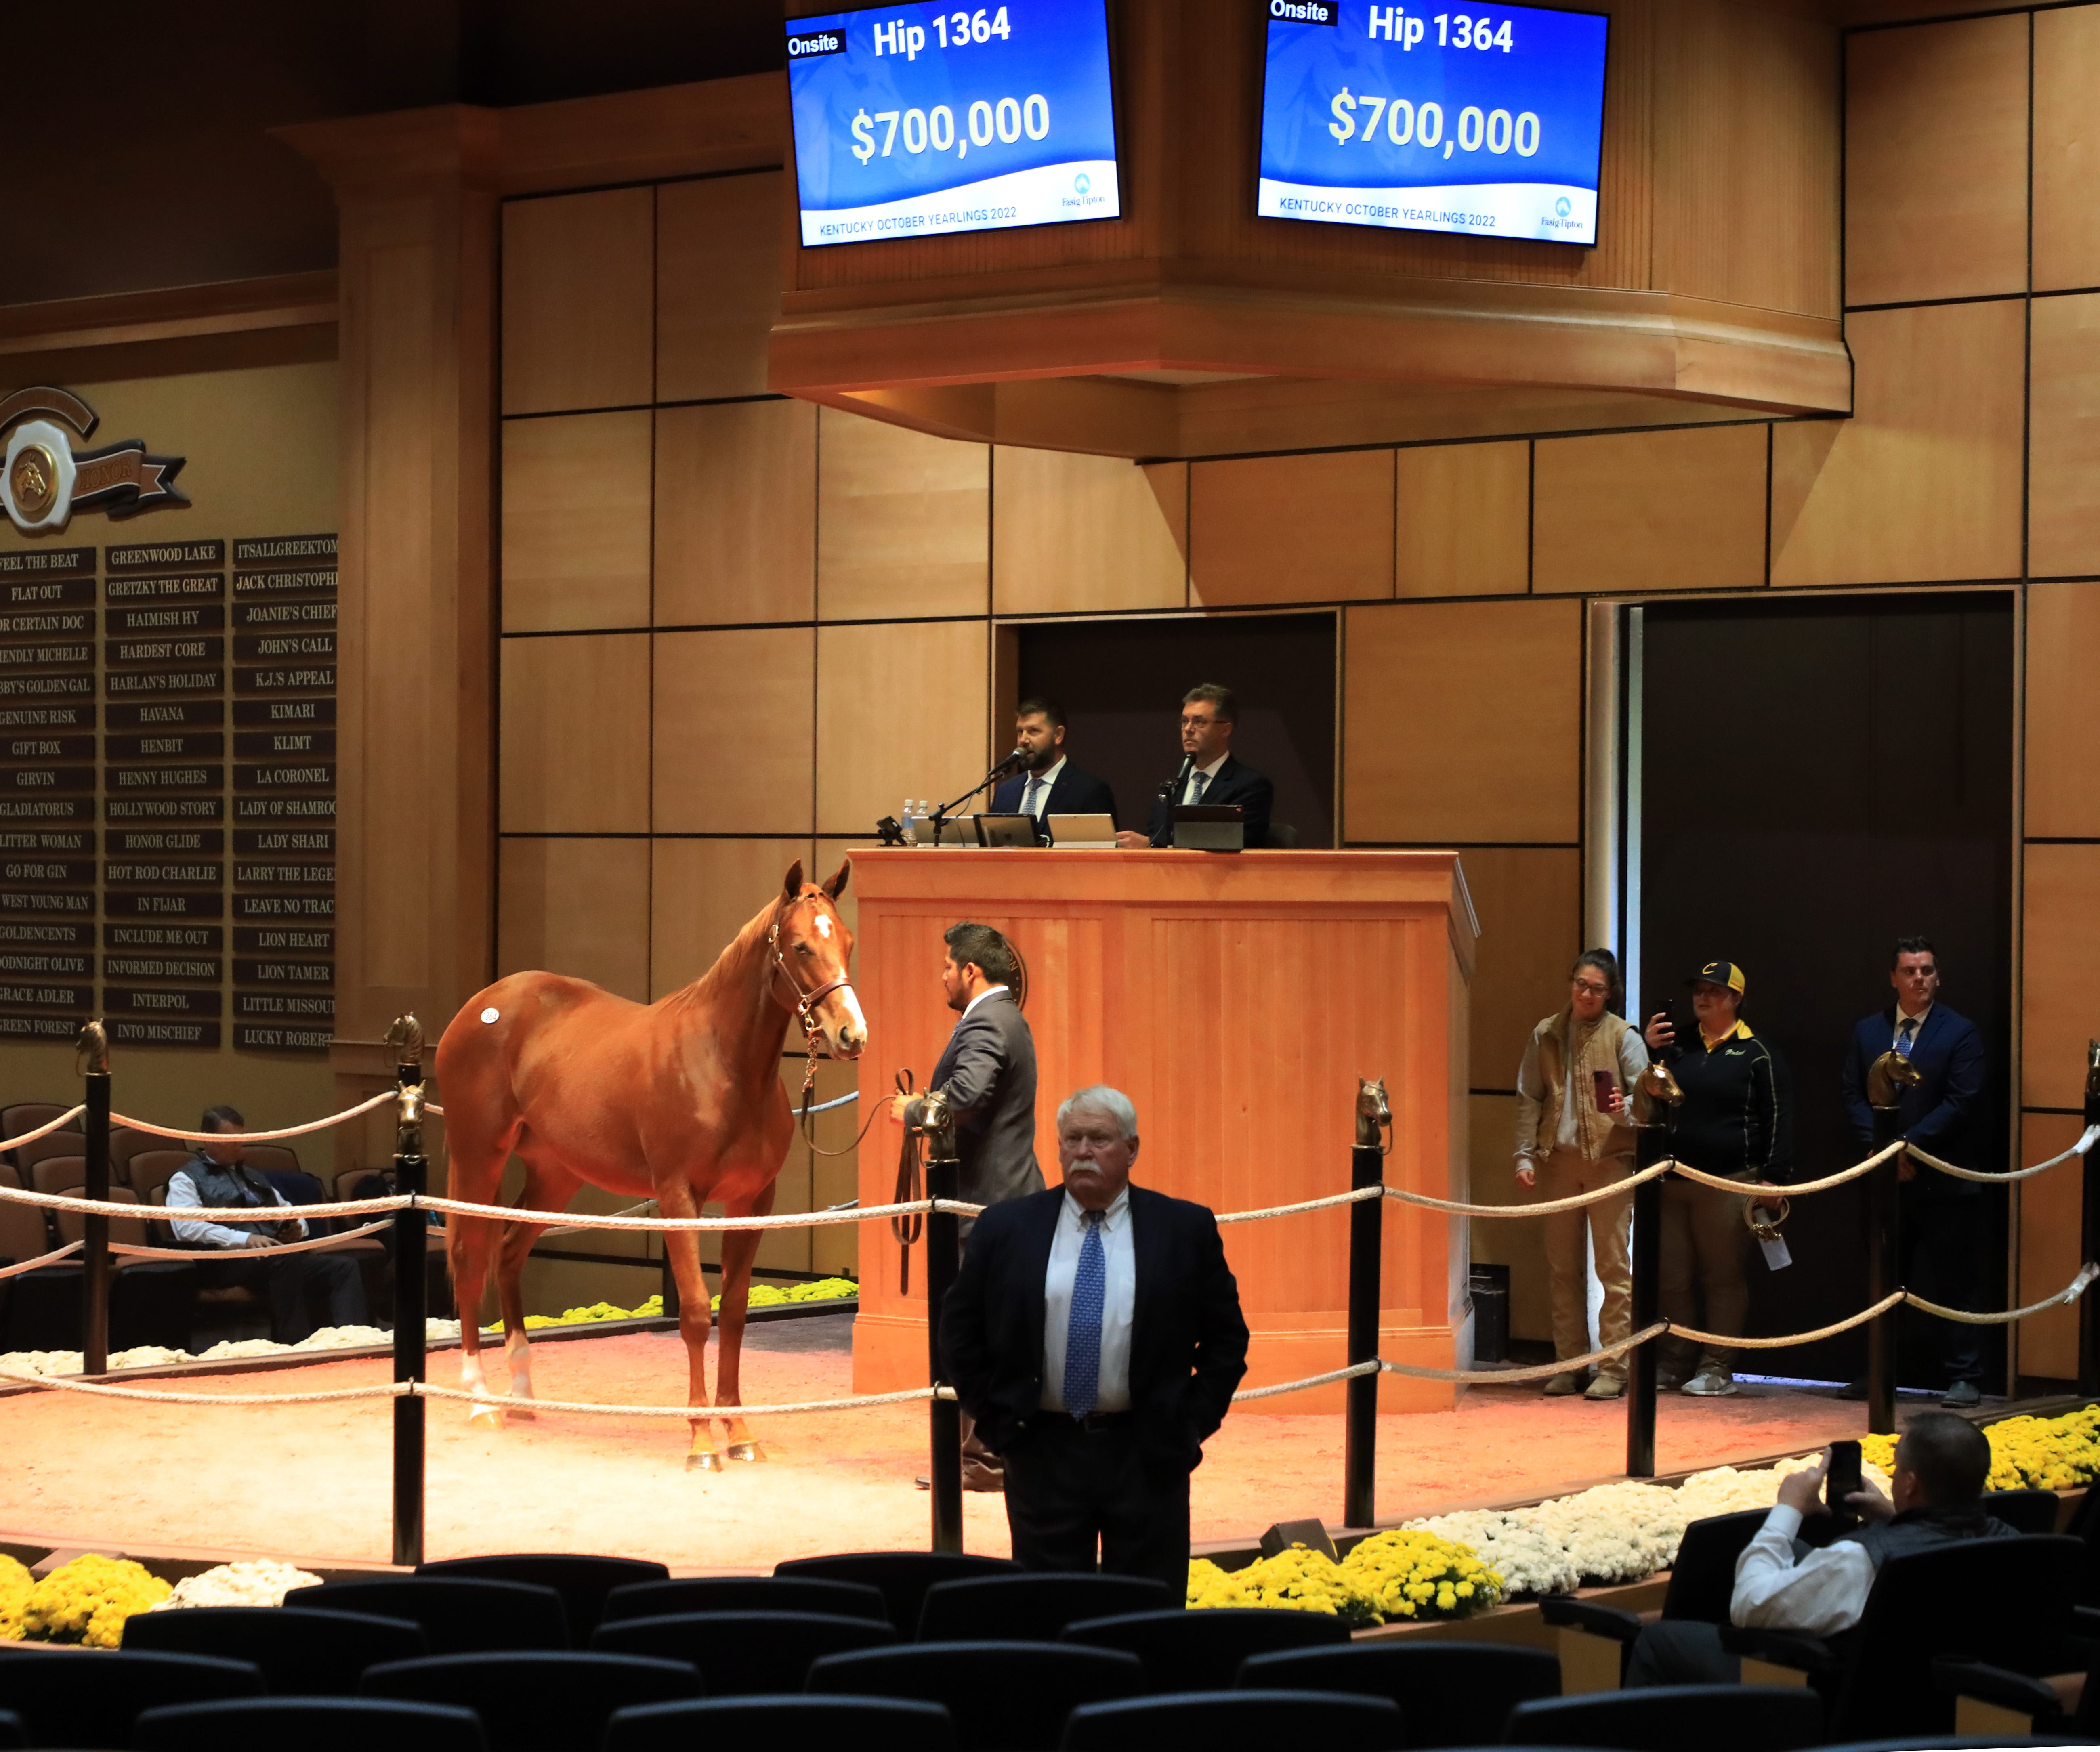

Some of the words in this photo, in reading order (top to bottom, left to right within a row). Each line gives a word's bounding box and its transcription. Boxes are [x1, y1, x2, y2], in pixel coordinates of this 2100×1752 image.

[1270, 0, 1329, 21] Onsite
[874, 20, 926, 61] Hip
[933, 6, 1011, 48] 1364
[1368, 5, 1424, 51] Hip
[1433, 13, 1514, 53] 1364
[788, 34, 838, 55] Onsite
[851, 93, 1050, 166] $700,000
[1328, 87, 1540, 161] $700,000
[1279, 197, 1342, 214] KENTUCKY
[1346, 202, 1399, 219] OCTOBER
[1403, 208, 1466, 225] YEARLINGS
[1468, 213, 1496, 227] 2022
[819, 220, 874, 236] KENTUCKY
[877, 214, 925, 231] OCTOBER
[928, 209, 988, 226] YEARLINGS
[991, 206, 1017, 220] 2022
[79, 457, 132, 489] HONOR
[26, 555, 47, 569] THE
[50, 554, 79, 568] BEAT
[111, 548, 182, 565] GREENWOOD
[185, 546, 216, 561] LAKE
[108, 580, 157, 596] GRETZKY
[159, 579, 180, 594] THE
[182, 577, 218, 593] GREAT
[236, 575, 265, 590] JACK
[11, 586, 38, 601] FLAT
[40, 585, 62, 599] OUT
[127, 611, 179, 627] HAIMISH
[183, 611, 200, 625] HY
[247, 606, 299, 622] JOANIE'S
[302, 604, 338, 619] CHIEF
[13, 616, 59, 631] CERTAIN
[63, 615, 84, 629] DOC
[120, 644, 172, 659] HARDEST
[175, 642, 205, 657] CORE
[258, 638, 298, 654] JOHN'S
[302, 638, 332, 652] CALL
[37, 647, 88, 662] MICHELLE
[26, 679, 67, 693] GOLDEN
[69, 678, 90, 692] GAL
[111, 675, 165, 690] HARLAN'S
[168, 673, 216, 688] HOLIDAY
[288, 671, 334, 686] APPEAL
[0, 710, 47, 725] GENUINE
[50, 710, 76, 724] RISK
[140, 707, 184, 722] HAVANA
[271, 704, 315, 718] KIMARI
[12, 741, 37, 755] GIFT
[39, 741, 61, 754] BOX
[141, 739, 183, 753] HENBIT
[274, 736, 312, 750] KLIMT
[17, 772, 55, 785] GIRVIN
[119, 771, 158, 785] HENNY
[161, 770, 207, 785] HUGHES
[257, 770, 271, 783] LA
[275, 768, 329, 783] CORONEL
[0, 802, 74, 816] GLADIATORUS
[109, 802, 177, 816] HOLLYWOOD
[181, 801, 216, 815] STORY
[239, 801, 267, 815] LADY
[270, 801, 284, 815] OF
[41, 834, 82, 848] WOMAN
[126, 835, 163, 848] HONOR
[166, 834, 201, 848] GLIDE
[258, 834, 289, 848] LADY
[292, 834, 329, 848] SHARI
[6, 864, 21, 878] GO
[24, 864, 44, 878] FOR
[47, 865, 67, 878] GIN
[108, 865, 132, 879] HOT
[135, 866, 159, 879] ROD
[162, 866, 216, 880] CHARLIE
[238, 867, 275, 880] LARRY
[277, 867, 300, 881] THE
[304, 867, 336, 881] LEGE
[2, 894, 29, 908] WEST
[30, 895, 63, 909] YOUNG
[66, 896, 88, 909] MAN
[138, 897, 149, 911] IN
[244, 899, 281, 913] LEAVE
[284, 899, 300, 913] NO
[0, 926, 76, 940] GOLDENCENTS
[114, 929, 162, 943] INCLUDE
[166, 930, 182, 944] ME
[185, 931, 208, 944] OUT
[259, 932, 286, 946] LION
[289, 933, 330, 947] HEART
[0, 956, 49, 971] ODNIGHT
[51, 957, 84, 972] OLIVE
[107, 960, 162, 975] INFORMED
[166, 962, 215, 976] DECISION
[258, 965, 285, 979] LION
[288, 965, 330, 980] TAMER
[36, 989, 74, 1004] ADLER
[132, 993, 189, 1009] INTERPOL
[243, 997, 284, 1011] LITTLE
[34, 1020, 75, 1034] FOREST
[118, 1024, 144, 1038] INTO
[147, 1025, 201, 1040] MISCHIEF
[244, 1029, 283, 1044] LUCKY
